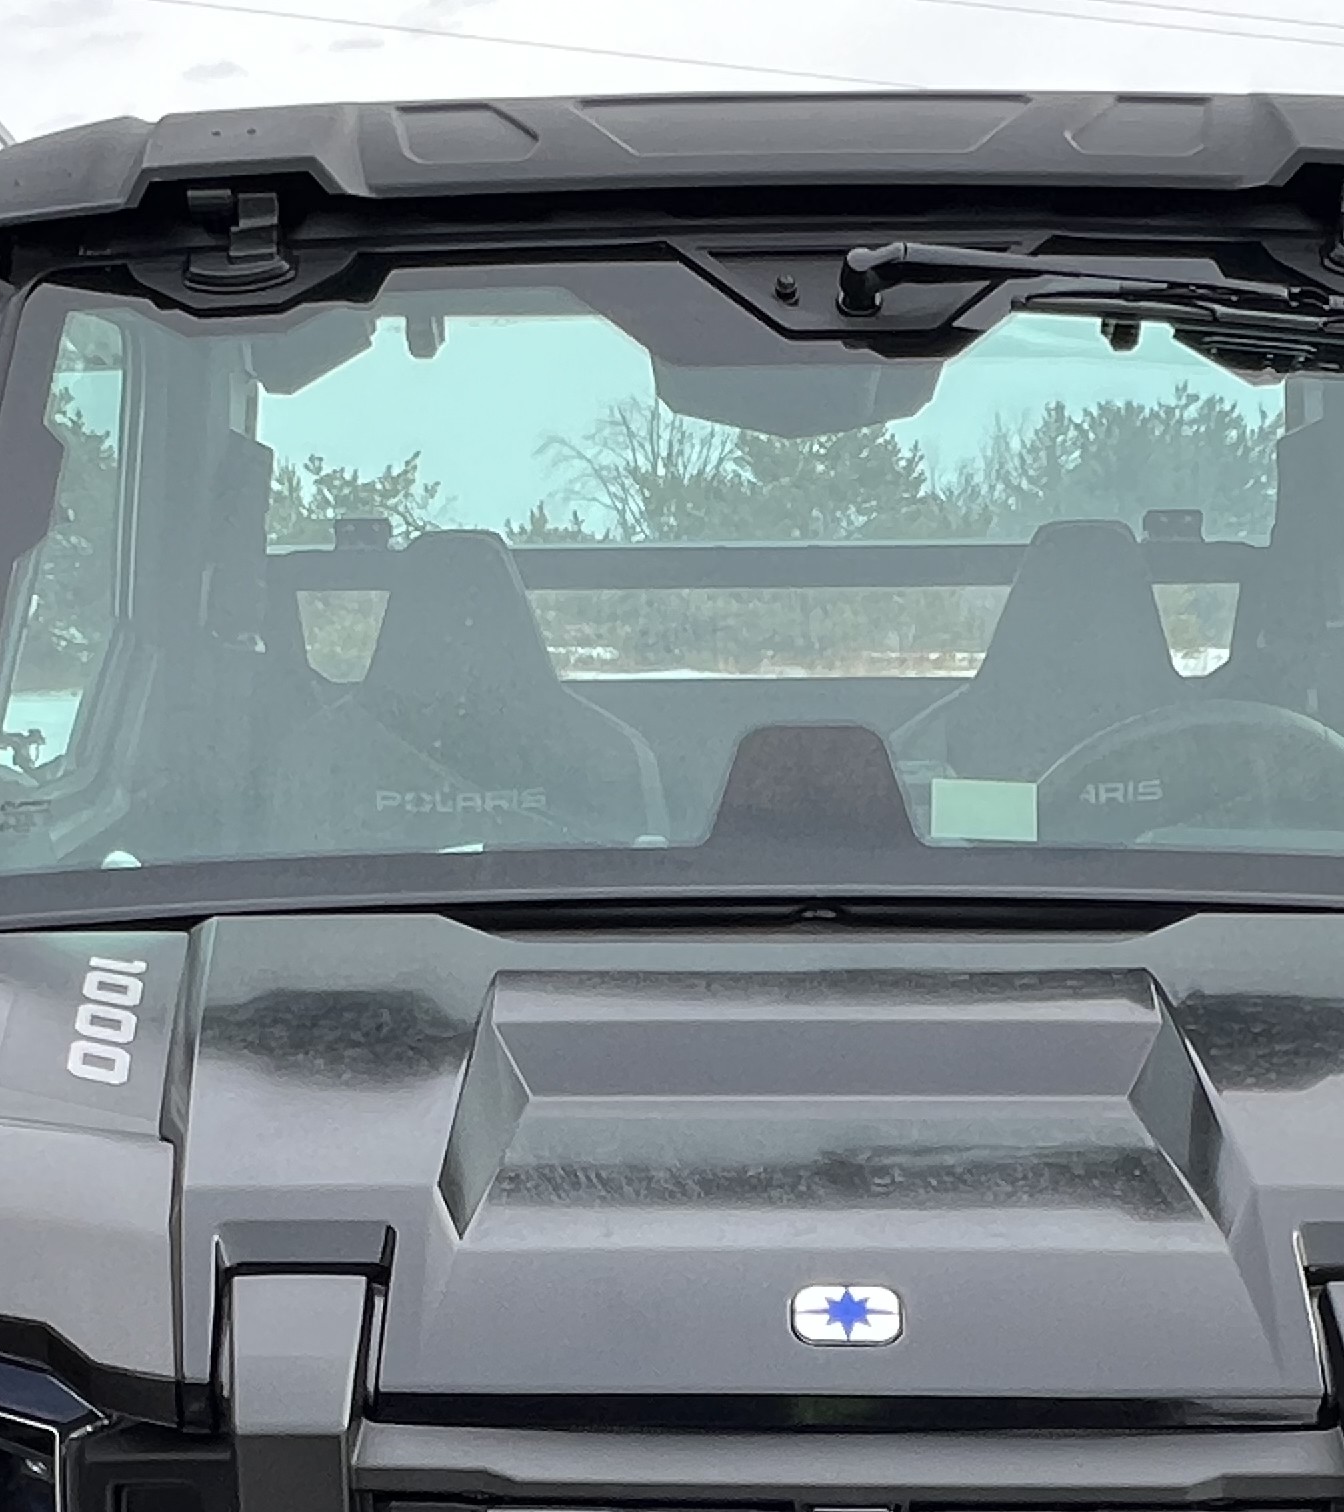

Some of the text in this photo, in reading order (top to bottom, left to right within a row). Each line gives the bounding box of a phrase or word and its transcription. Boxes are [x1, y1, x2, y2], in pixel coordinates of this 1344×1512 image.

[375, 787, 547, 814] POLARIS
[1078, 778, 1164, 804] ARIS
[66, 956, 148, 1086] 1000
